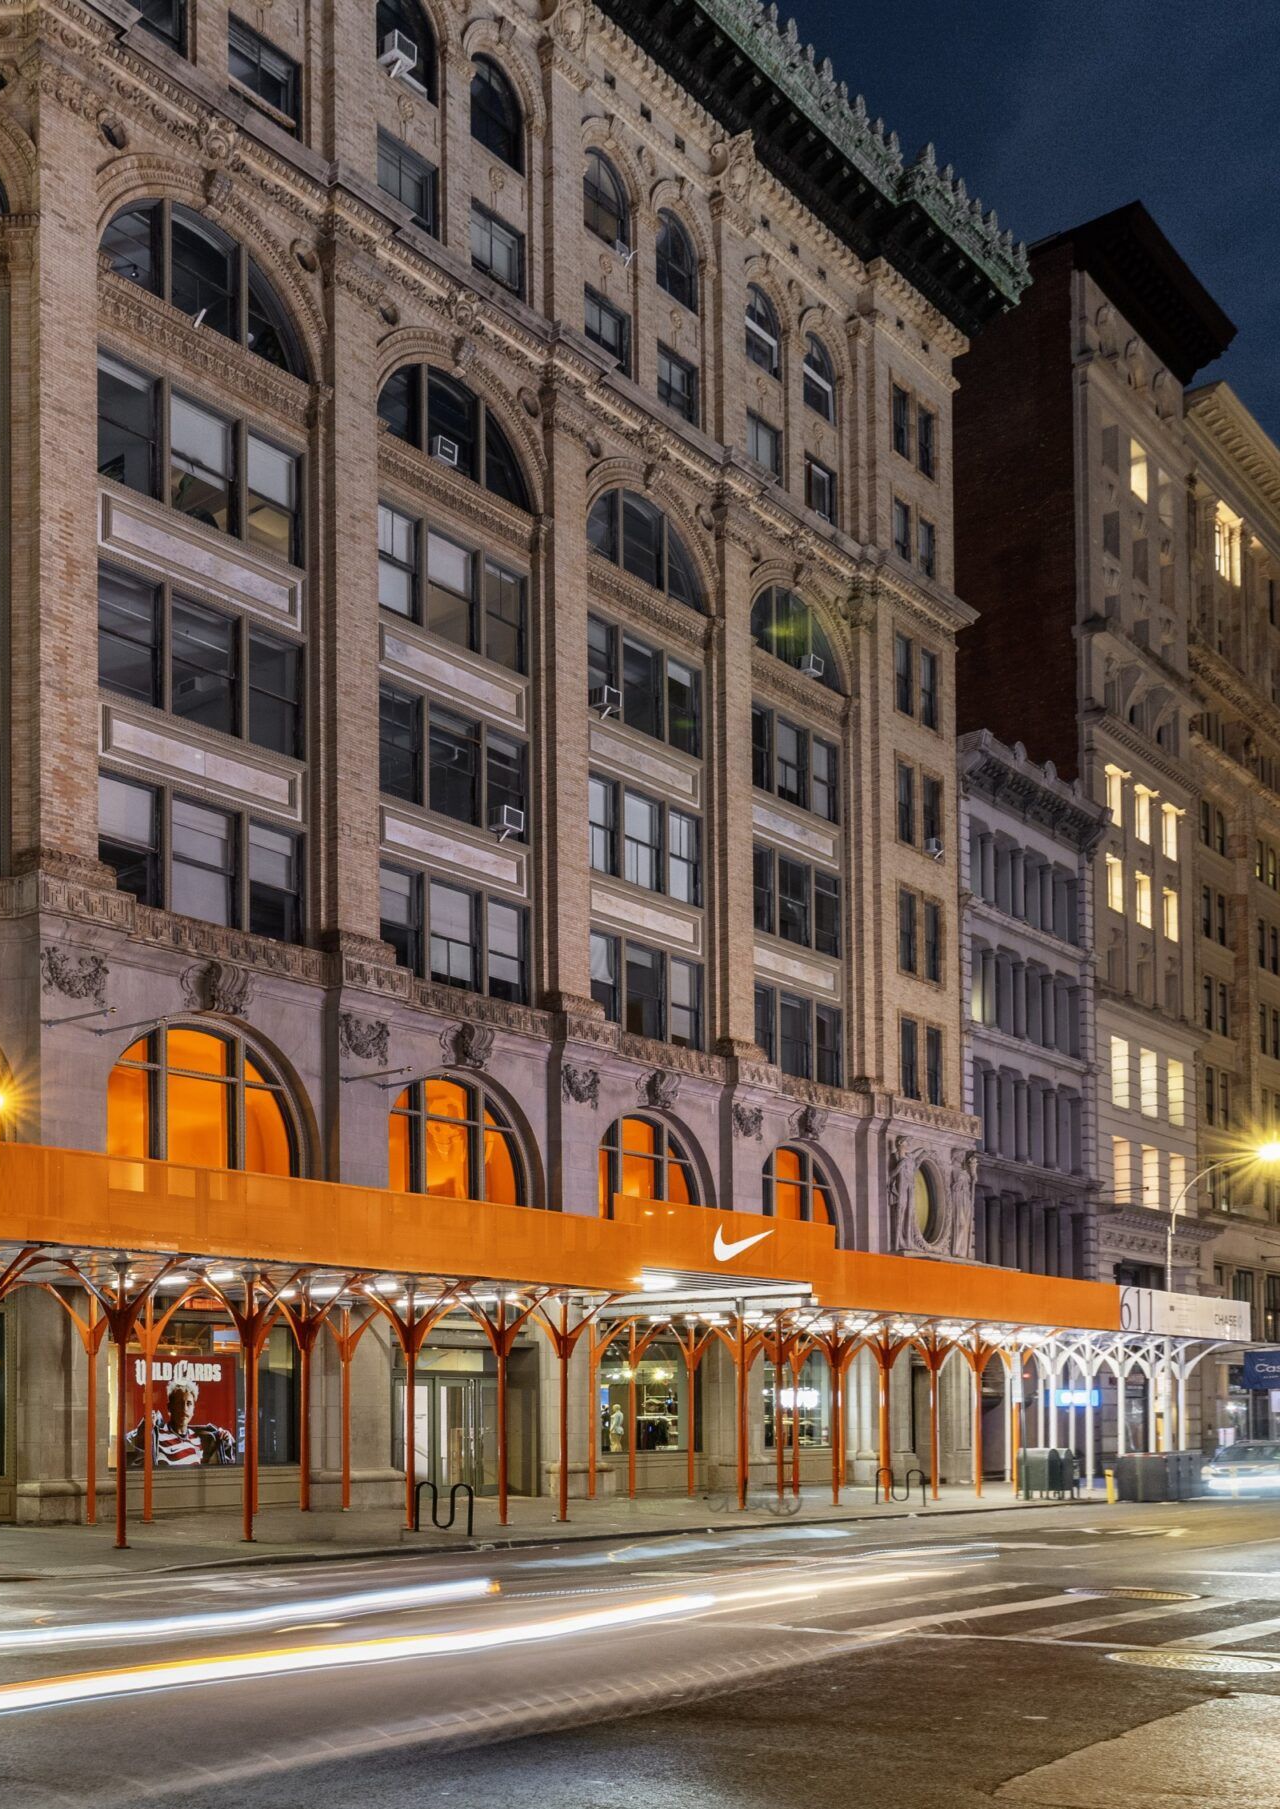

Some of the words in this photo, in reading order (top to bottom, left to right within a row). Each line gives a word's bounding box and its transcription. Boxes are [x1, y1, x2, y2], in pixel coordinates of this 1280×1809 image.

[1120, 1286, 1154, 1332] 611
[1214, 1313, 1237, 1327] CHASE
[173, 1359, 222, 1384] CARDS
